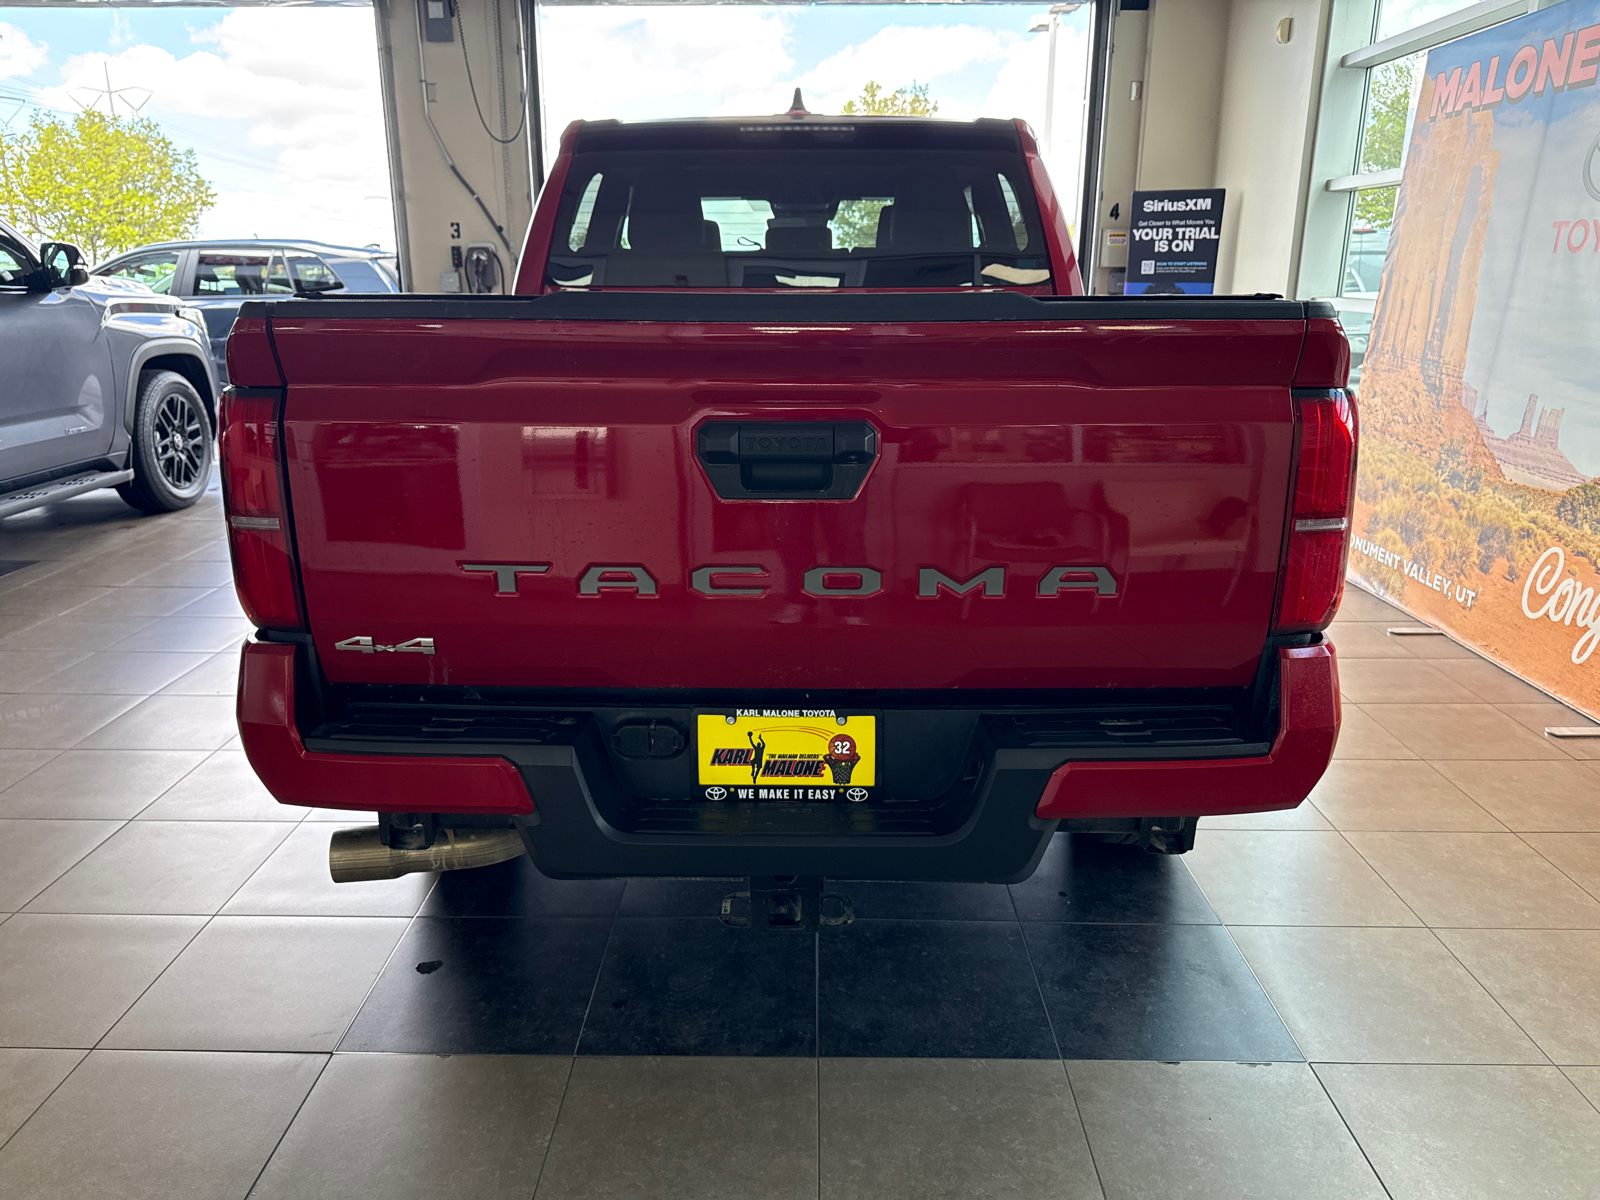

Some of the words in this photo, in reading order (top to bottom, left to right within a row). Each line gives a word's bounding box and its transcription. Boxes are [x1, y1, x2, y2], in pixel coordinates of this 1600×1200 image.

[1429, 24, 1600, 122] MALONE
[1109, 202, 1120, 221] 4
[1143, 198, 1212, 212] SiriusXM
[450, 222, 461, 239] 3
[1132, 228, 1173, 241] YOUR
[1175, 226, 1219, 240] TRIAL
[1154, 240, 1169, 253] IS
[1171, 240, 1195, 252] ON
[745, 437, 829, 452] TOYOTA
[1350, 533, 1401, 570] ONUMENT
[1403, 559, 1452, 600] VALLEY,
[1455, 584, 1476, 608] UT
[457, 561, 1120, 598] TACOMA
[736, 708, 761, 717] KARL
[763, 709, 800, 717] MALONE
[802, 709, 836, 717] TOYOTA
[834, 741, 851, 755] 32
[710, 748, 754, 766] KARL
[761, 760, 826, 777] MALONE
[738, 788, 755, 799] WE
[758, 788, 790, 799] MAKE
[794, 789, 804, 799] IT
[808, 789, 836, 799] EASY
